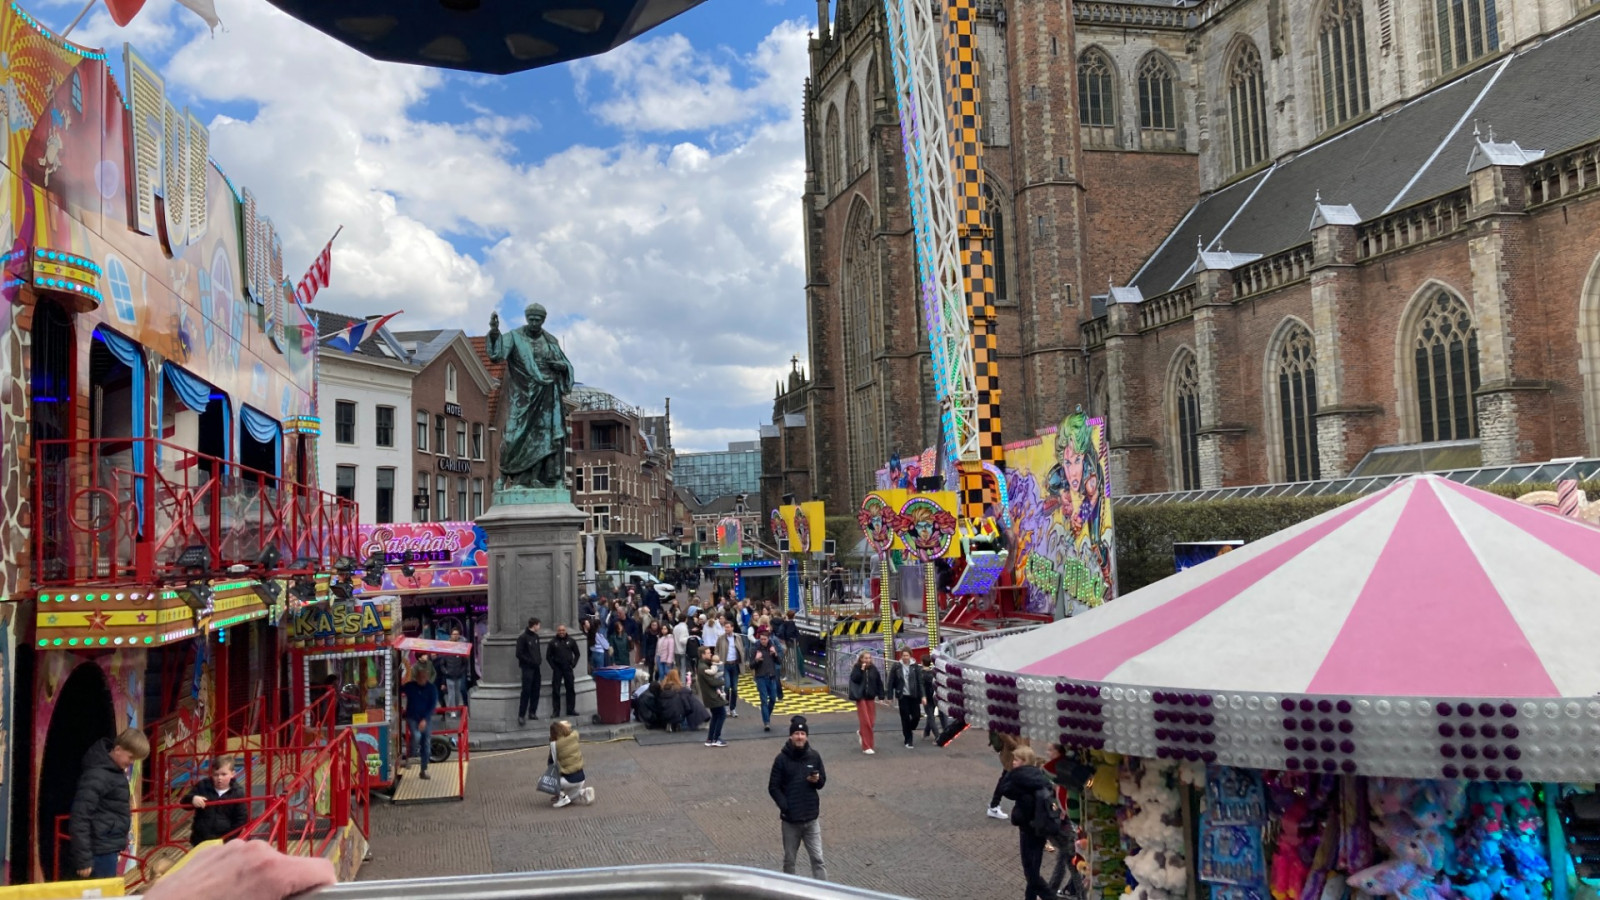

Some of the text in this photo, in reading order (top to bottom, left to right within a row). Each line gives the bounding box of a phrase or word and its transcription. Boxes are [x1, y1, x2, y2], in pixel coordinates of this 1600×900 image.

[446, 404, 464, 417] HOTEL
[440, 458, 472, 473] CARILLON
[361, 527, 461, 560] Sascha's
[413, 551, 445, 561] DATE
[294, 602, 384, 636] KASSA
